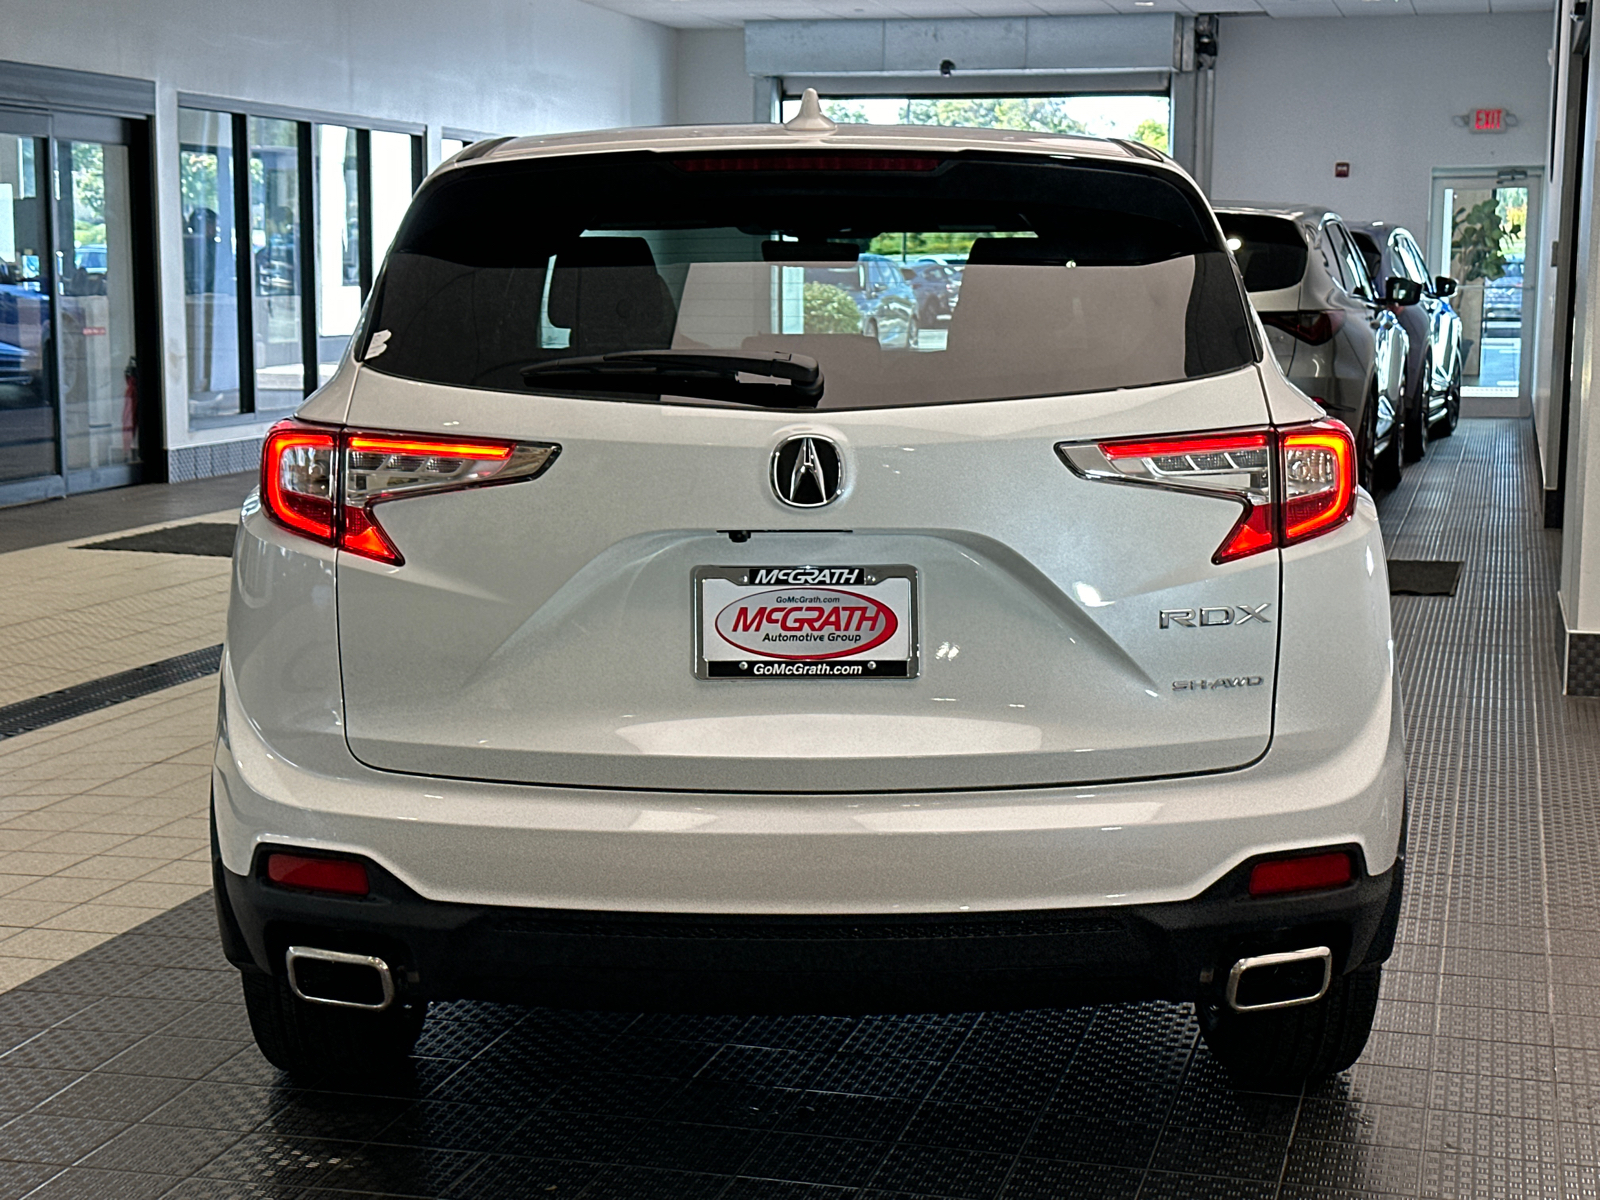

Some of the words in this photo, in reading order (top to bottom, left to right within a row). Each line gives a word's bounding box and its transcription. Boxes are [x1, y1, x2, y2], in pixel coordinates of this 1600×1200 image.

[1475, 109, 1502, 130] EXIT
[775, 596, 840, 604] GoMcGrath.com
[1159, 603, 1271, 629] RDX
[762, 633, 825, 642] Automotive
[827, 633, 862, 643] Group
[753, 664, 863, 675] GoMcGrath.com
